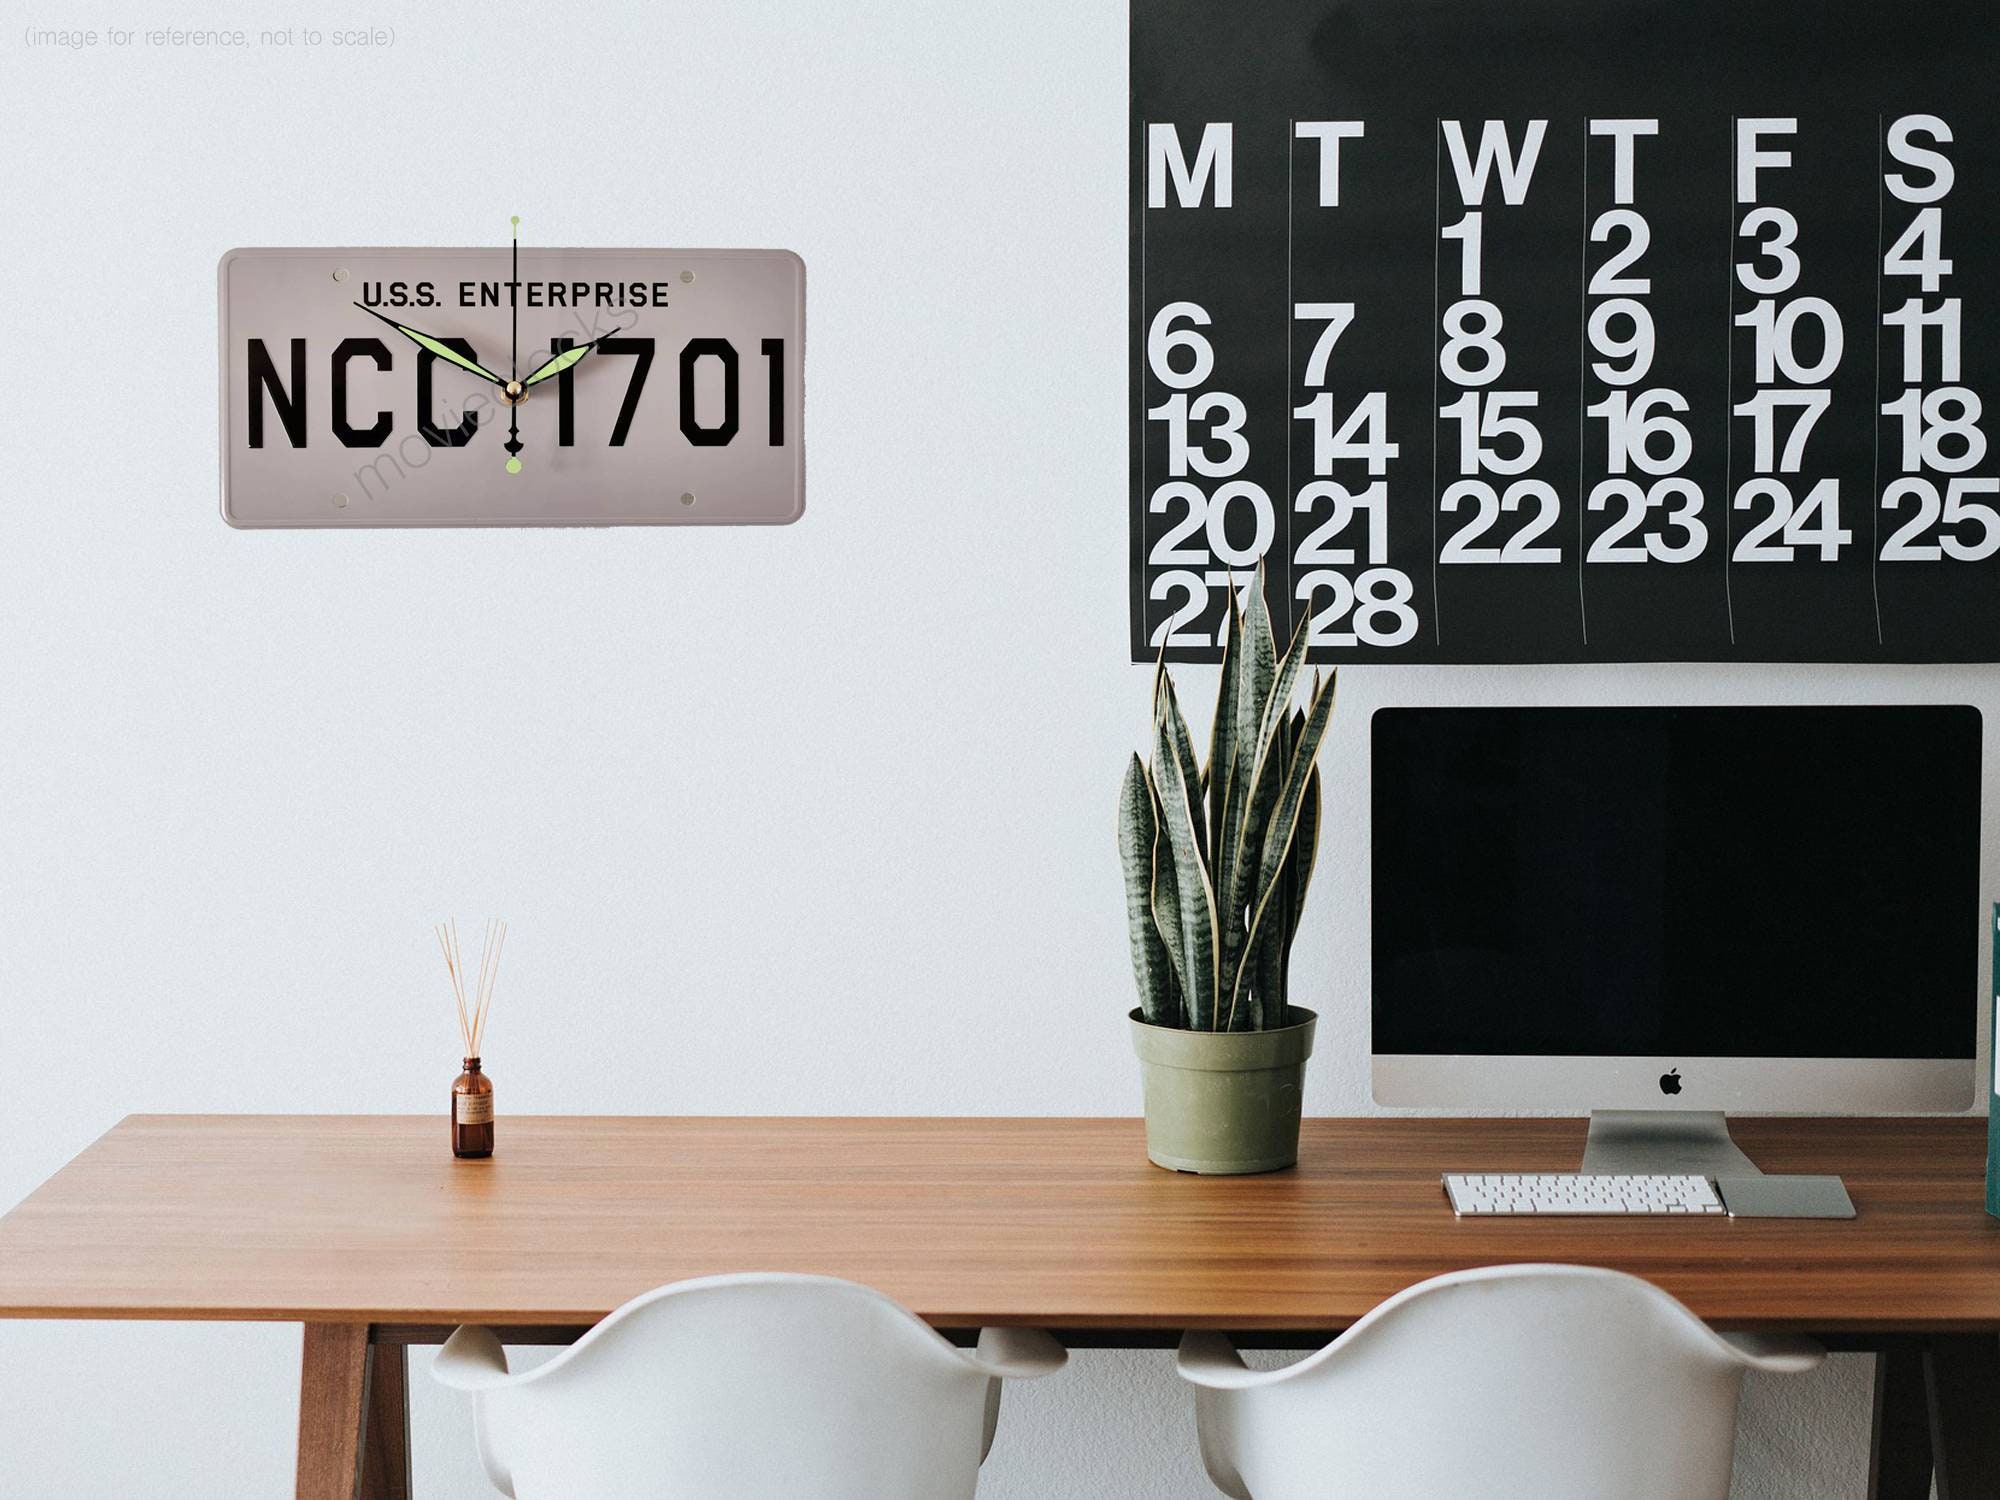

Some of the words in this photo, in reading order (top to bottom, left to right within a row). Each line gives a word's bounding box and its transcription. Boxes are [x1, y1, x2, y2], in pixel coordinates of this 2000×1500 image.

[1148, 122, 1233, 209] M
[1295, 120, 1365, 207] T
[1441, 119, 1549, 206] W
[1589, 118, 1659, 205] T
[1737, 117, 1798, 203] F
[1884, 114, 1955, 204] S
[363, 281, 441, 308] U.S.S.
[459, 281, 669, 308] ENTERPRISE
[1441, 211, 1483, 296] 1
[1587, 209, 1651, 295] 2
[1735, 206, 1801, 295] 3
[1883, 207, 1953, 292] 4
[1147, 301, 1215, 390] 6
[1294, 302, 1355, 387] 7
[1439, 299, 1507, 387] 8
[1587, 298, 1656, 386] 9
[1734, 296, 1844, 385] 10
[1882, 298, 1962, 383] 11
[247, 337, 479, 449] NCC
[550, 336, 785, 447] 1701
[1147, 391, 1250, 478] 13
[1293, 391, 1400, 476] 14
[1439, 390, 1543, 476] 15
[1586, 388, 1693, 476] 16
[1733, 388, 1832, 473] 17
[1881, 386, 1987, 473] 18
[1148, 480, 1276, 566] 20
[1293, 480, 1389, 565] 21
[1439, 479, 1562, 564] 22
[1586, 477, 1709, 564] 23
[1731, 477, 1853, 562] 24
[1879, 476, 2000, 562] 25
[1295, 567, 1419, 647] 28
